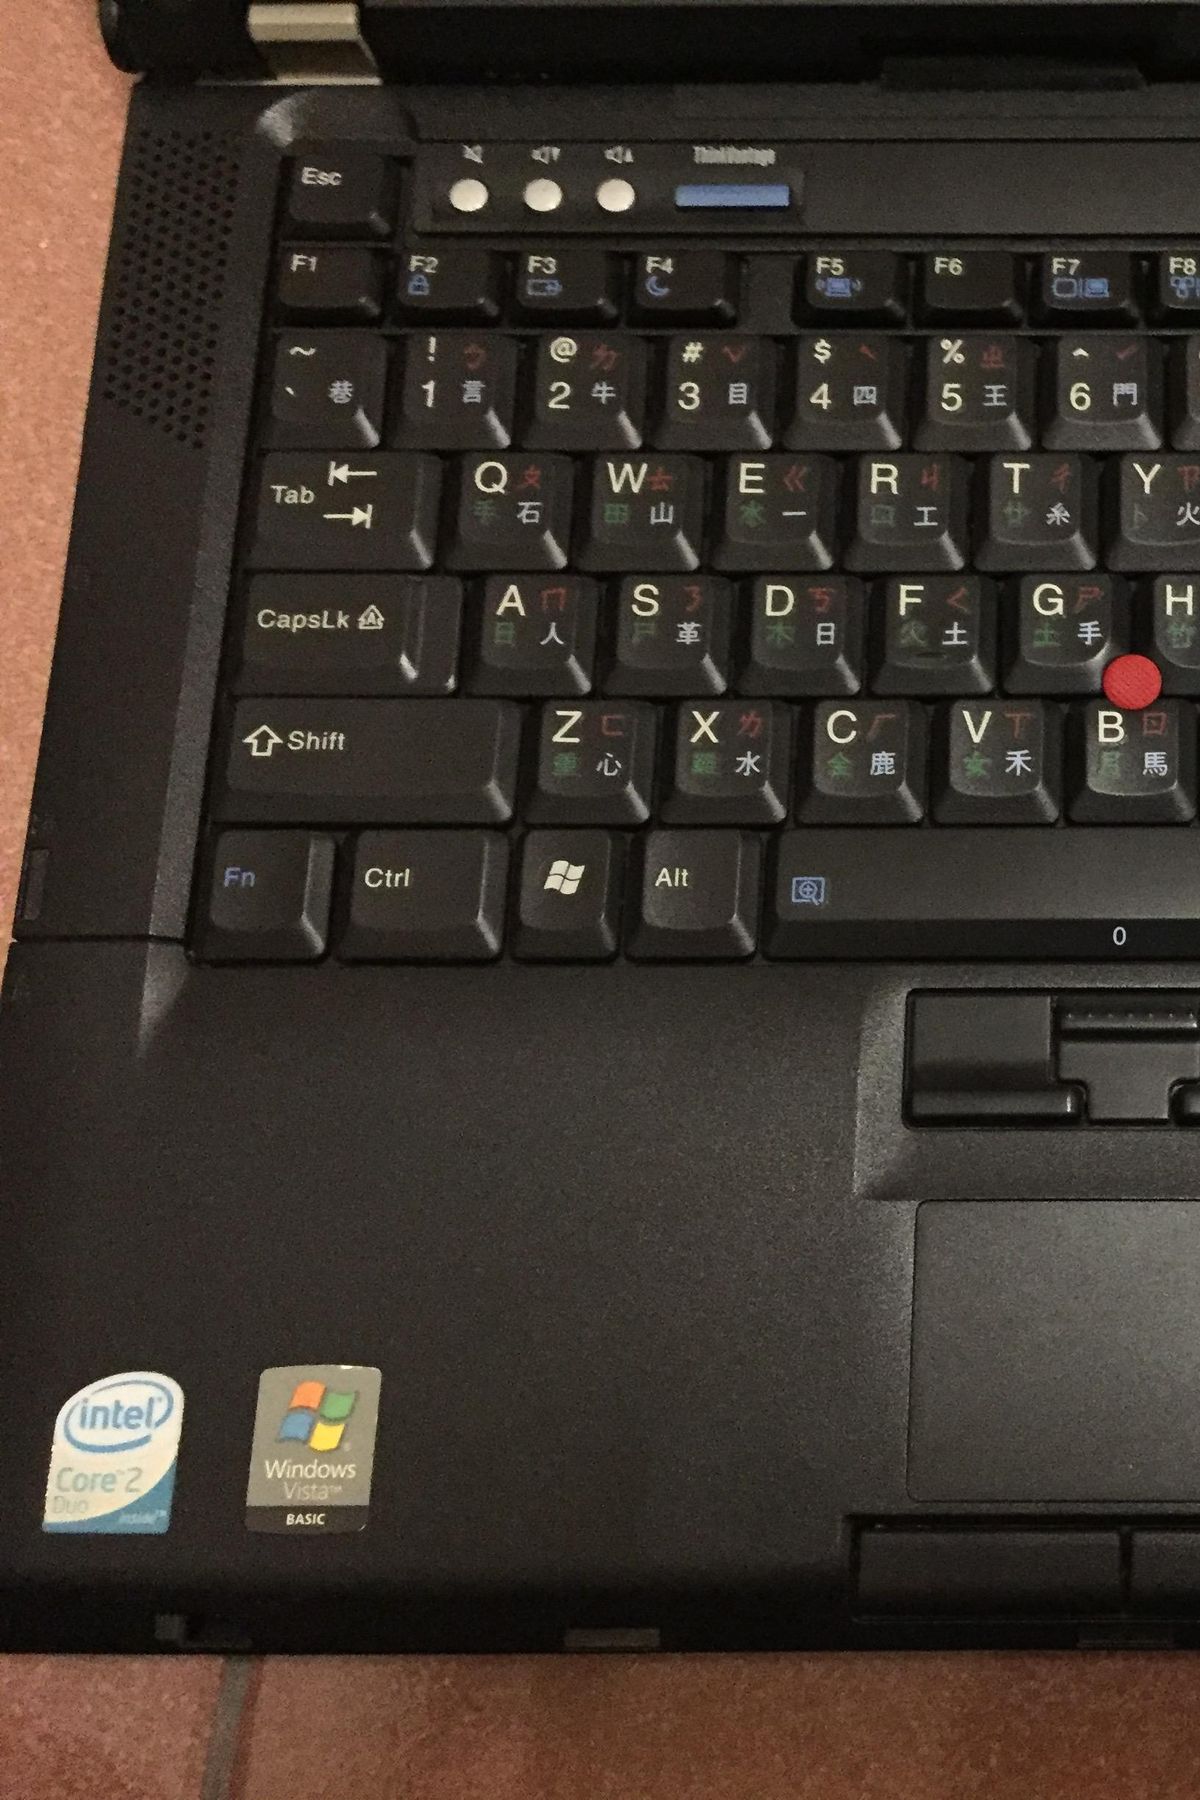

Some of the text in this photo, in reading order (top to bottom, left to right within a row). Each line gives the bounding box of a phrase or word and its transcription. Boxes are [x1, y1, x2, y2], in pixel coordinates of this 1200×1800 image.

[302, 167, 341, 185] Esc
[291, 254, 316, 271] F1
[410, 256, 438, 273] F2
[528, 256, 556, 274] F3
[646, 257, 673, 273] F4
[817, 257, 844, 275] F5
[935, 257, 962, 275] F6
[1053, 258, 1080, 275] F7
[1170, 257, 1196, 275] F8
[427, 337, 436, 361] !
[550, 337, 577, 363] @
[683, 342, 703, 362] #
[814, 339, 831, 363] $
[941, 339, 965, 363] %
[422, 380, 435, 407] 1
[463, 381, 485, 403] 言
[549, 382, 571, 409] 2
[592, 382, 615, 404] 牛
[679, 382, 700, 410] 3
[729, 383, 747, 404] 目
[810, 383, 831, 409] 4
[853, 386, 876, 405] 四
[942, 383, 962, 411] 5
[984, 385, 1006, 406] 王
[1070, 383, 1090, 410] 6
[1113, 383, 1137, 406] 門
[475, 462, 507, 494] Q
[607, 463, 647, 493] W
[739, 463, 765, 493] E
[871, 463, 898, 494] R
[1003, 463, 1030, 493] T
[1133, 463, 1161, 494] Y
[271, 486, 314, 504] Tab
[517, 502, 541, 524] 石
[651, 502, 673, 524] 山
[914, 507, 938, 526] 工
[1177, 502, 1200, 525] 火
[496, 585, 525, 616] A
[632, 584, 658, 616] S
[766, 585, 794, 616] D
[900, 585, 924, 616] F
[1033, 584, 1063, 615] G
[1166, 585, 1193, 615] H
[258, 609, 349, 632] CapsLk
[540, 622, 564, 645] 人
[676, 622, 701, 644] 革
[817, 623, 835, 645] 日
[943, 622, 967, 645] 土
[1078, 621, 1102, 645] 手
[552, 711, 582, 743] Z
[691, 711, 719, 743] X
[827, 710, 857, 743] C
[963, 711, 992, 743] V
[1099, 711, 1124, 742] B
[288, 731, 345, 750] Shift
[596, 753, 622, 776] 心
[736, 751, 760, 776] 水
[871, 751, 895, 775] 鹿
[1006, 750, 1031, 775] 禾
[1143, 752, 1167, 776] 馬
[224, 867, 255, 887] Fn
[365, 868, 409, 887] Ctrl
[655, 868, 688, 886] Alt
[80, 1398, 155, 1430] intel
[125, 1467, 142, 1492] 2
[265, 1459, 355, 1478] Windows
[54, 1497, 88, 1514] Duo
[286, 1514, 325, 1525] BASIC
